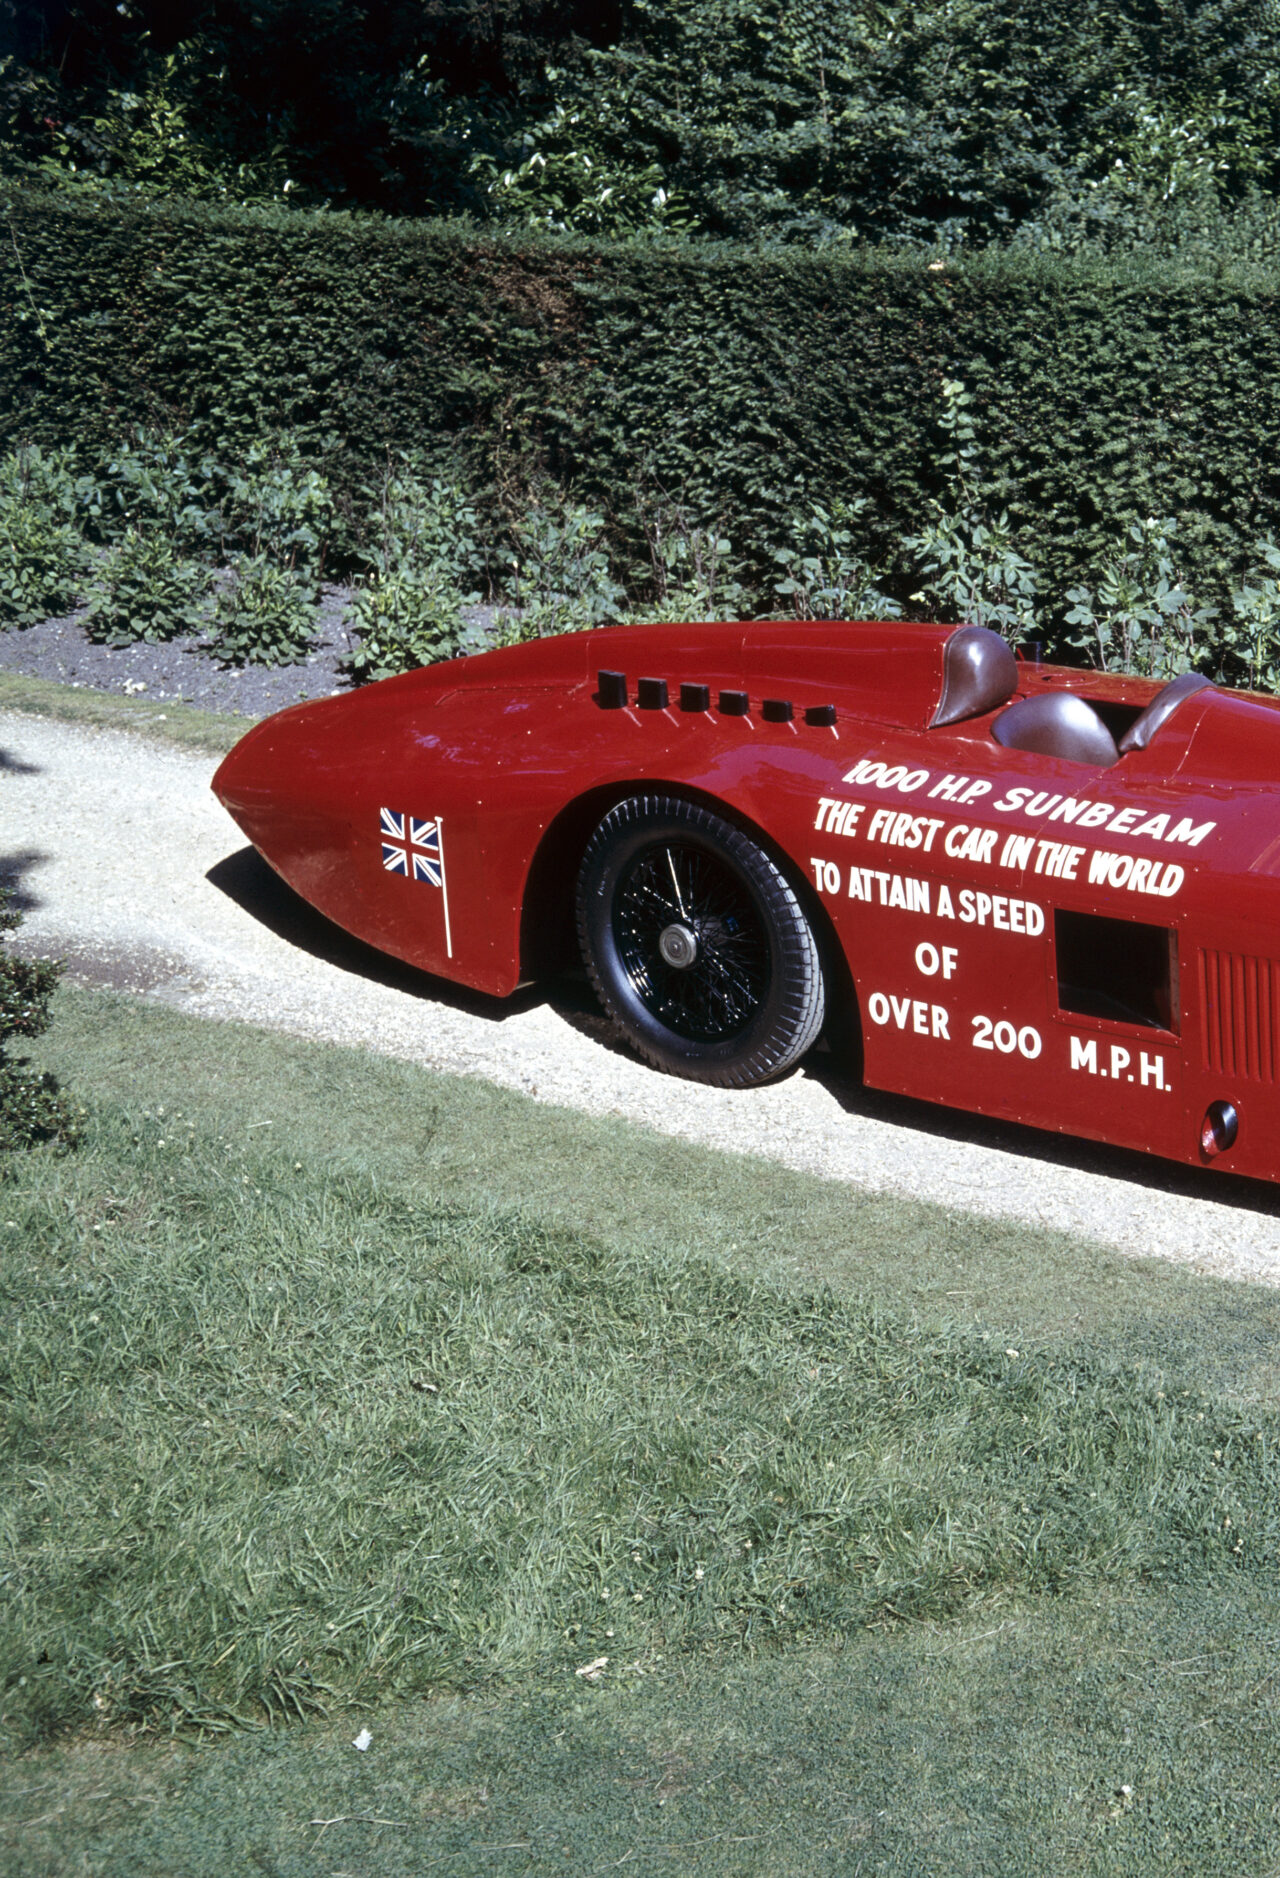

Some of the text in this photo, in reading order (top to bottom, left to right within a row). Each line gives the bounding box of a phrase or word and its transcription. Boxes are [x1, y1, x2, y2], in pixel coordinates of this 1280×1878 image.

[813, 798, 1185, 897] THE FIRST CAR IN THE WORLD
[927, 774, 993, 805] H.P.
[993, 787, 1217, 847] SUNBEAM
[810, 857, 1045, 937] TO ATTAIN A SPEED
[914, 942, 959, 980] OF
[868, 992, 1172, 1092] OVER 200 M.P.H.
